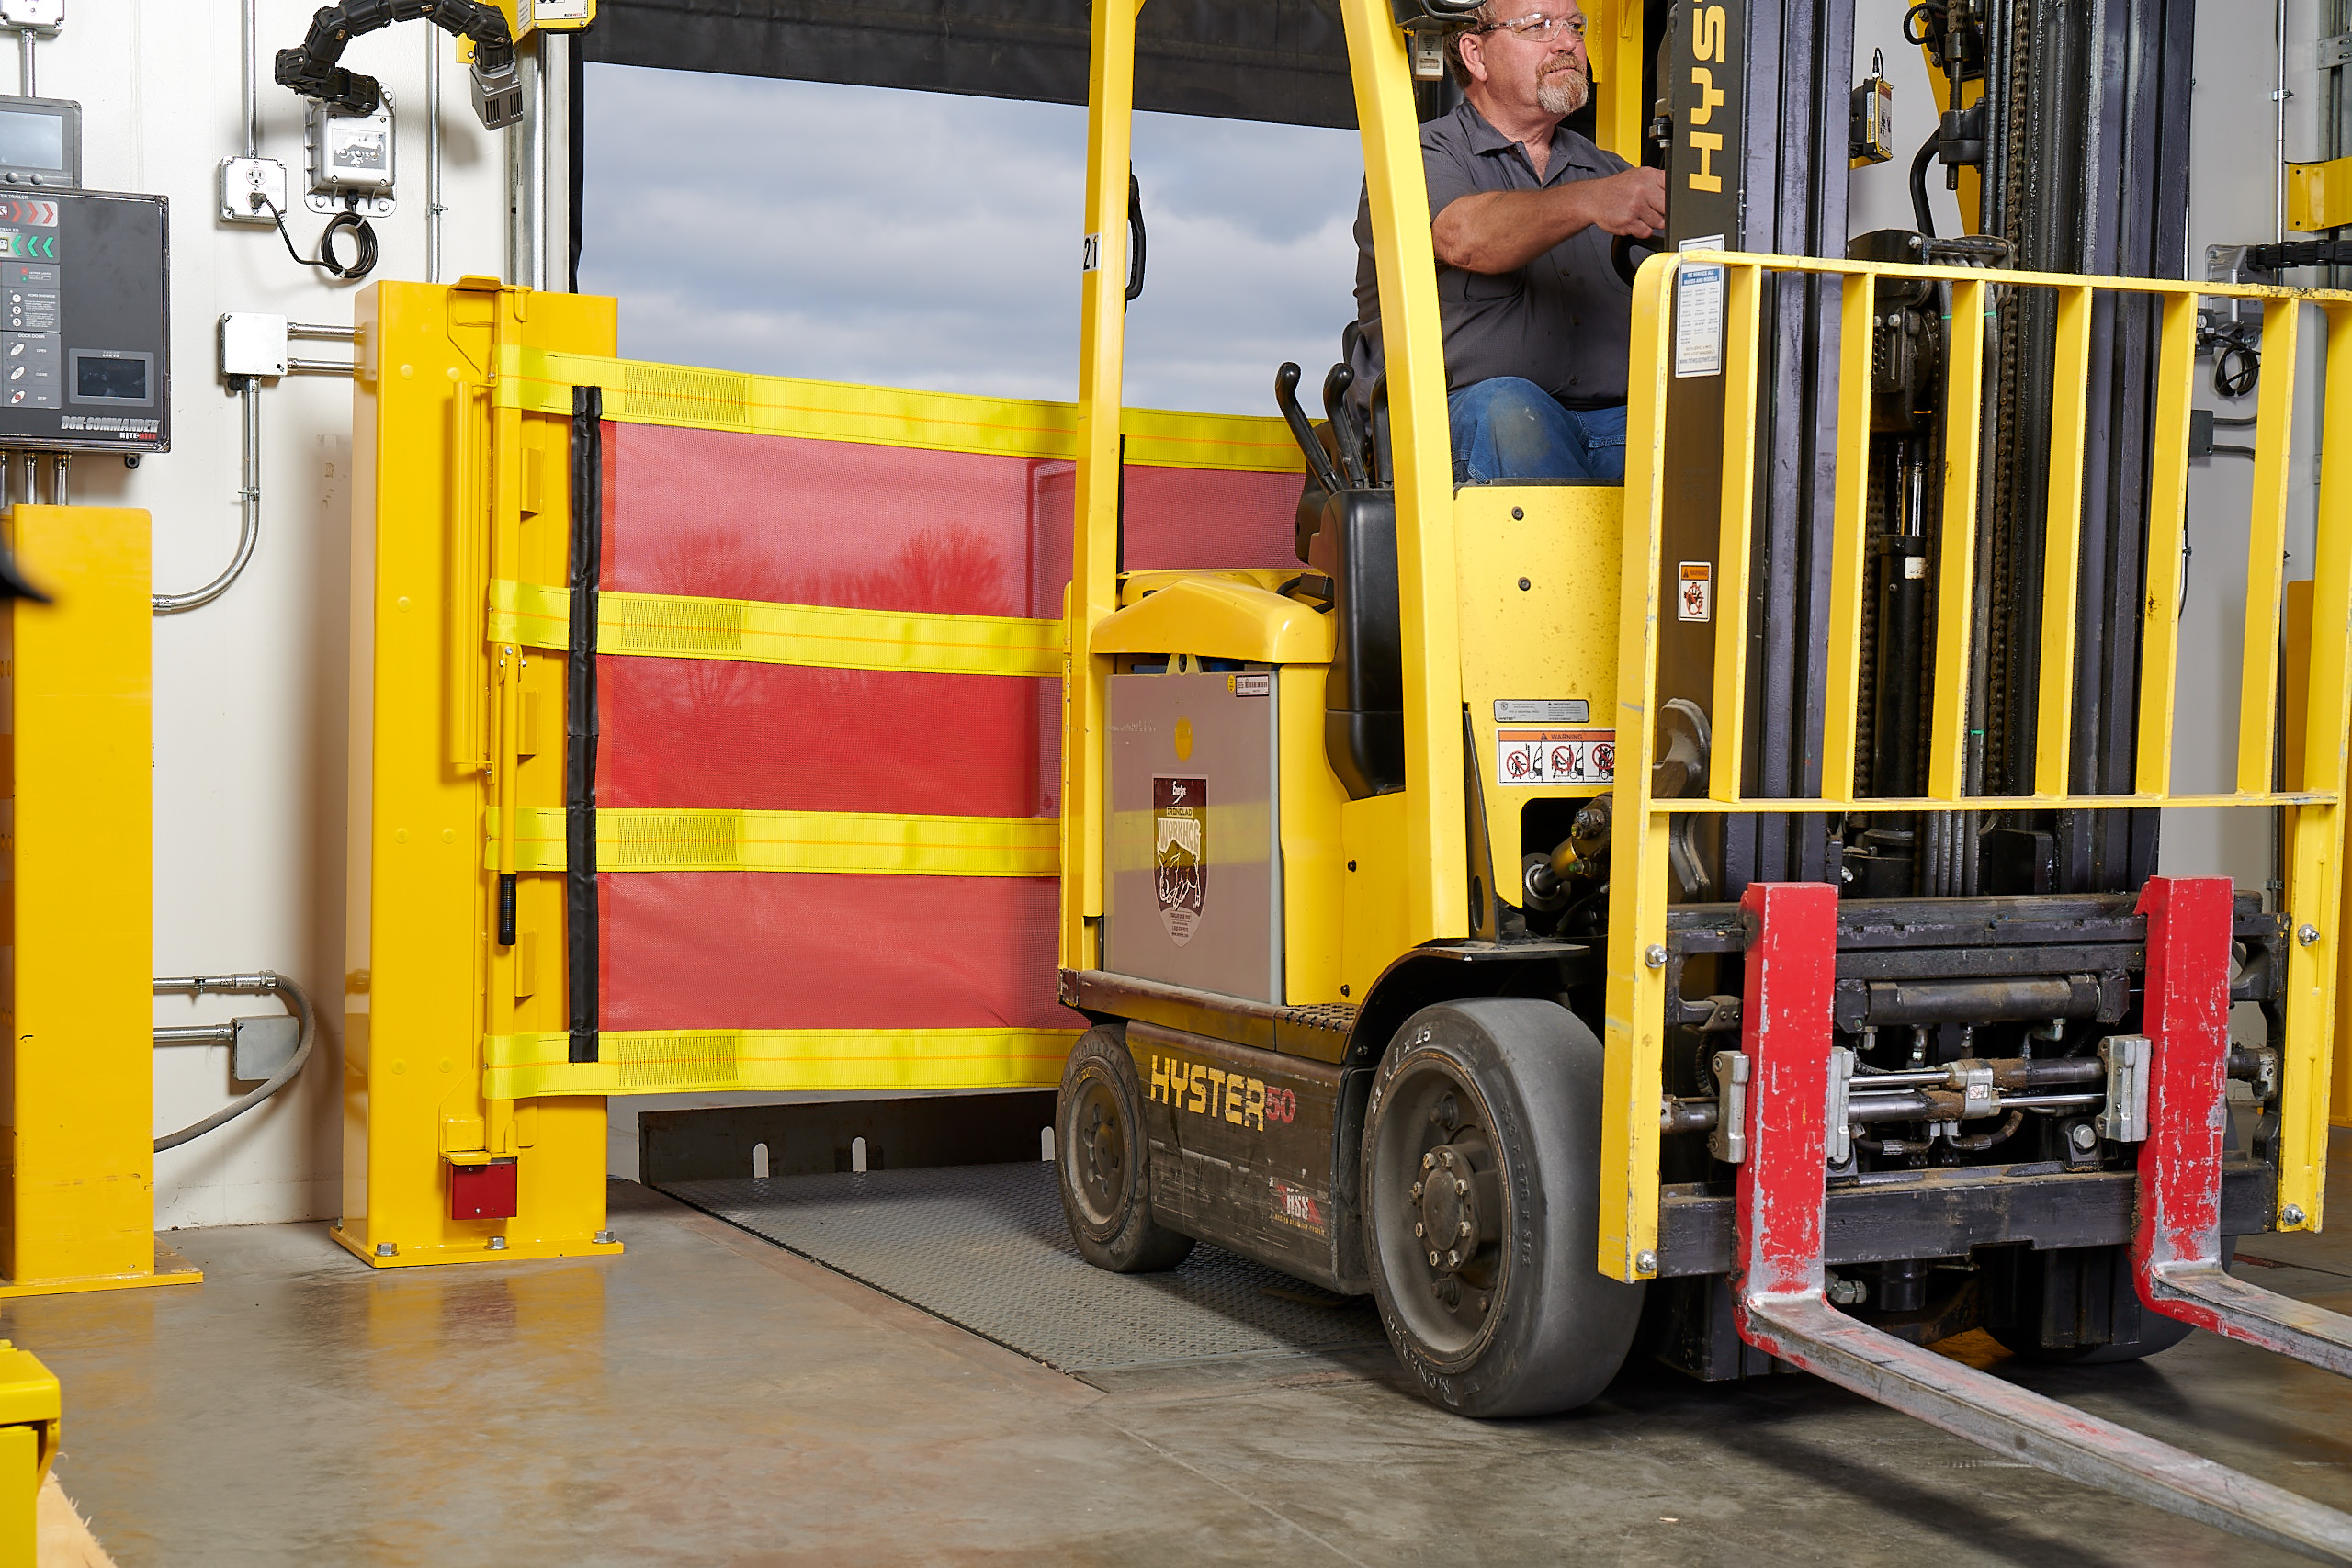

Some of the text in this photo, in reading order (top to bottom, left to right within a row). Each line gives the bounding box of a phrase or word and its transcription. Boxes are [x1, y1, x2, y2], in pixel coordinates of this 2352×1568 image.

[1689, 0, 1726, 193] HYS
[1083, 235, 1099, 270] 21
[1158, 817, 1201, 862] WORKHOG
[1150, 1055, 1296, 1132] HYSTER 50
[1286, 1187, 1309, 1221] HSS
